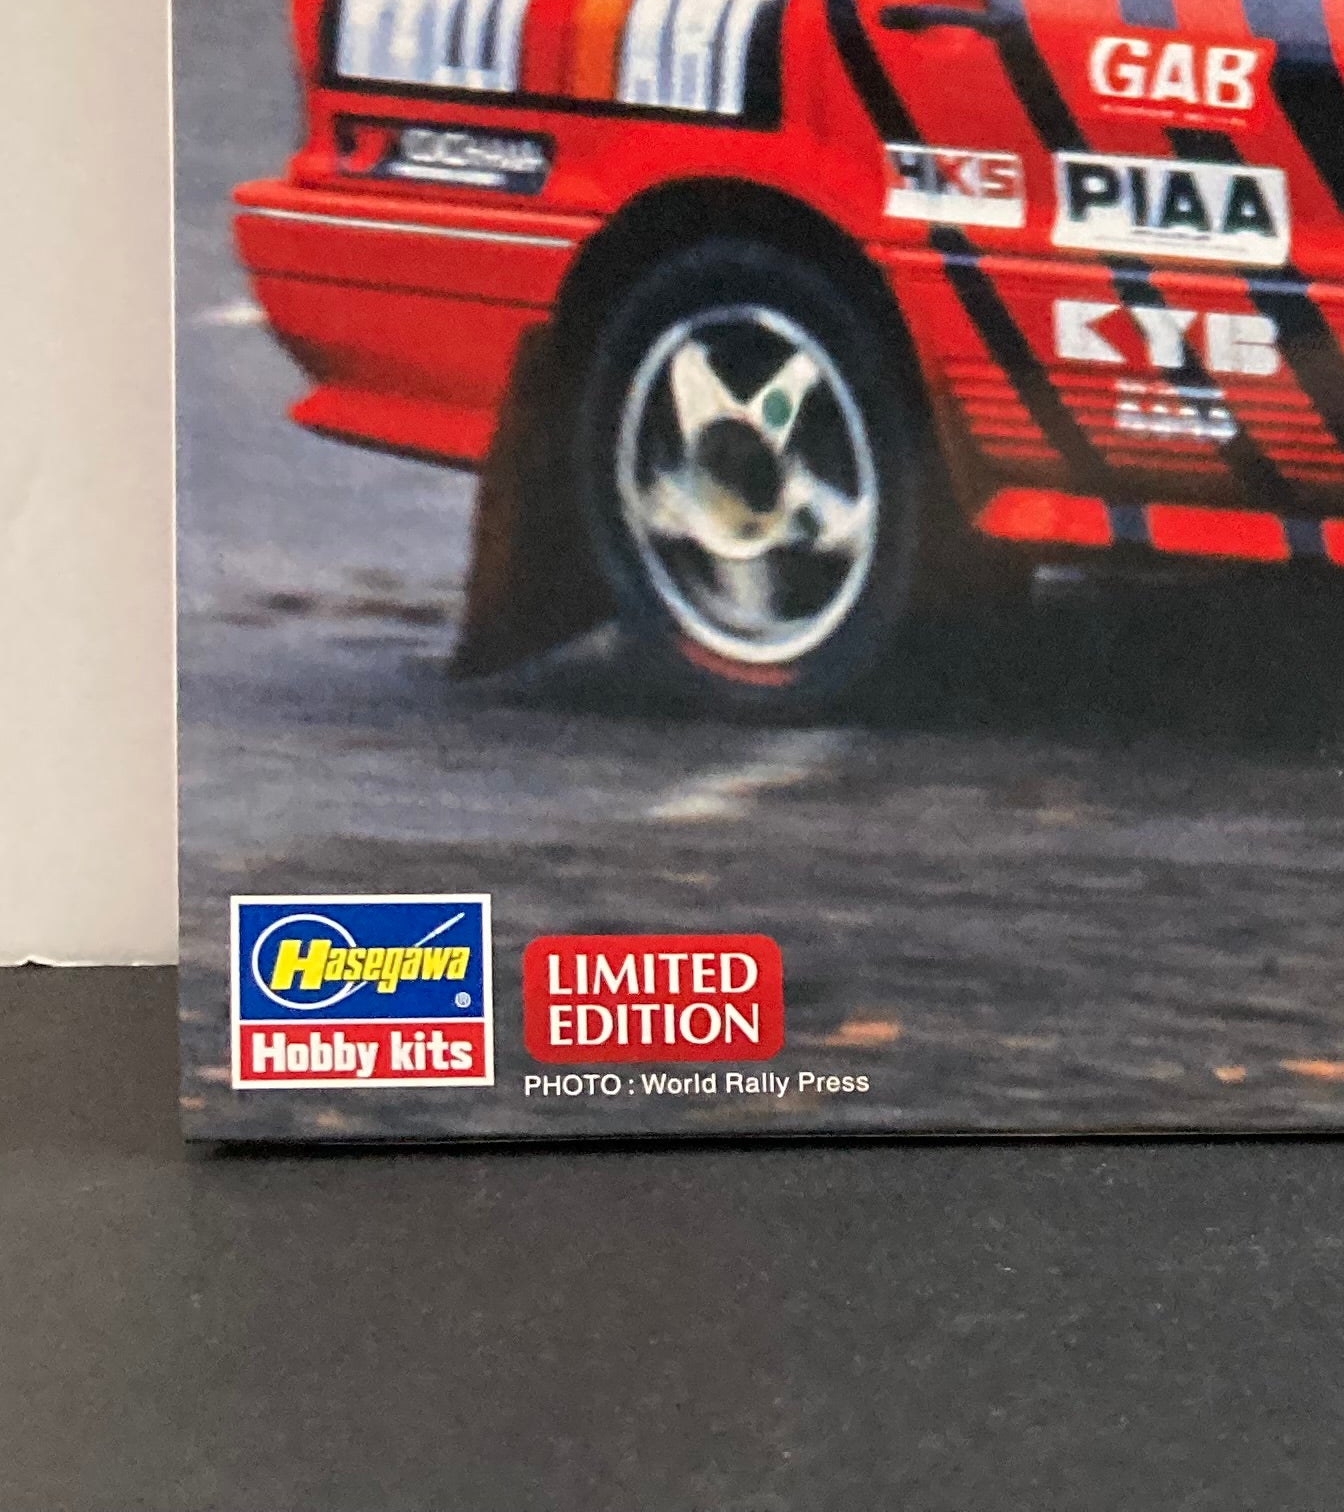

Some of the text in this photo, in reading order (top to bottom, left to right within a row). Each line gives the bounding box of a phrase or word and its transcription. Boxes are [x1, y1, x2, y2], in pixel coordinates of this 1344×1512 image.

[1088, 36, 1258, 110] GAB
[1065, 160, 1278, 238] PIAA
[1054, 299, 1280, 376] KYB
[270, 939, 471, 994] Hasegawa
[549, 952, 758, 996] LIMITED
[549, 1002, 761, 1047] EDITION
[252, 1029, 474, 1079] Hobby kits
[524, 1074, 622, 1097] PHOTO
[641, 1073, 717, 1095] World
[725, 1072, 790, 1098] Rally
[798, 1071, 871, 1094] Press
